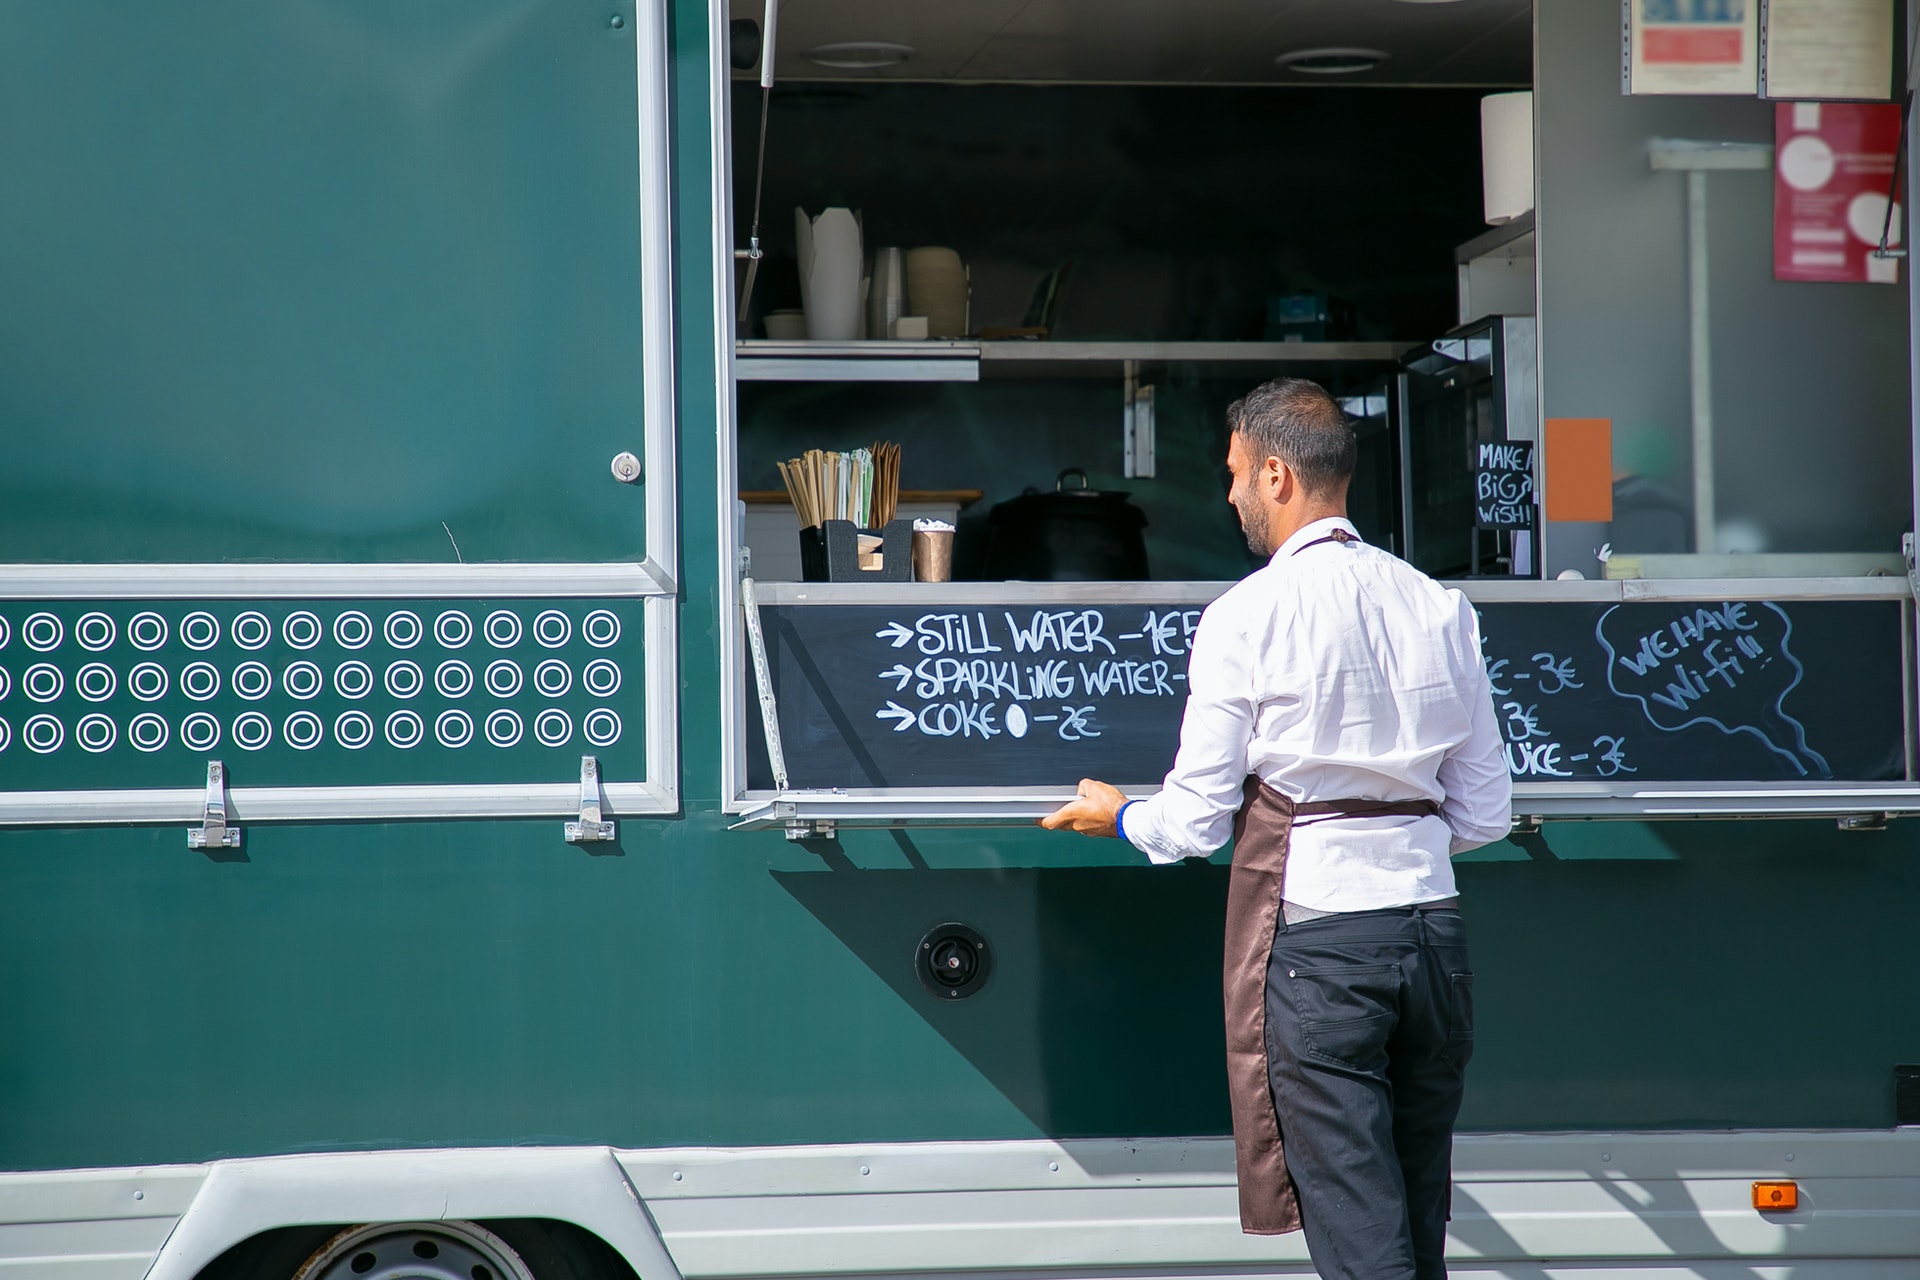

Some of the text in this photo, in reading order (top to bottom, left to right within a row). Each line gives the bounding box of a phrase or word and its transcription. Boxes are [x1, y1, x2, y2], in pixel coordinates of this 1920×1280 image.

[1479, 443, 1524, 471] MAKE
[1004, 610, 1116, 655] WATER
[1619, 602, 1758, 676] WE HAVE
[1078, 659, 1174, 697] WATER
[917, 700, 1001, 739] COKE
[1502, 701, 1551, 741] 3€
[1502, 742, 1573, 777] UiCE
